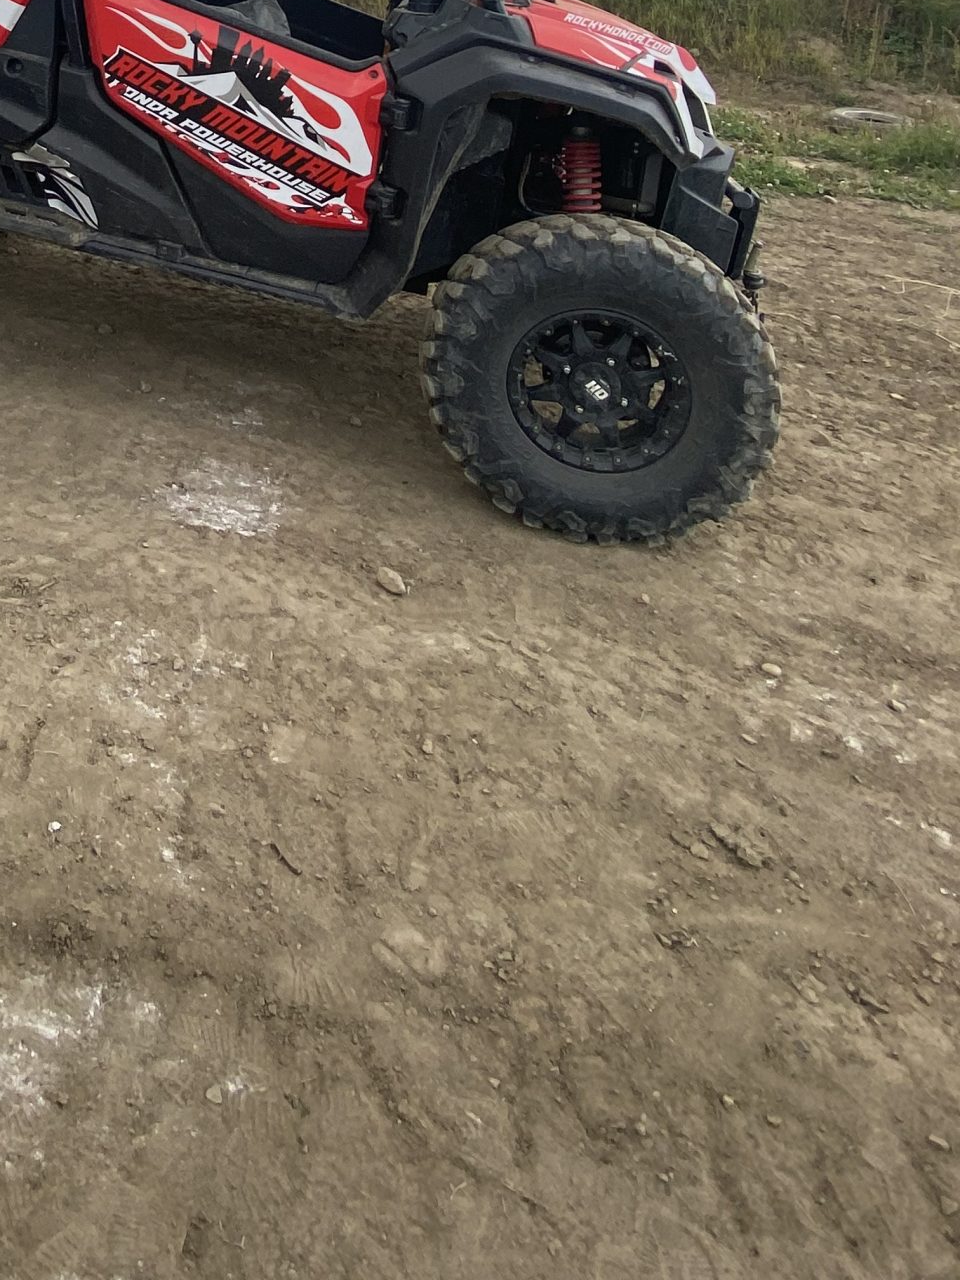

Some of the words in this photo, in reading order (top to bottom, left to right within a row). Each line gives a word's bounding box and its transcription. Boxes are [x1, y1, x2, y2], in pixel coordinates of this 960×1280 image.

[564, 13, 673, 54] ROCKYHONDA.COM
[108, 54, 208, 111] ROCKY
[201, 104, 354, 193] MOUNTAIN
[108, 77, 179, 120] ONDA
[179, 118, 330, 201] POWERHOUSE
[584, 380, 609, 400] HD
